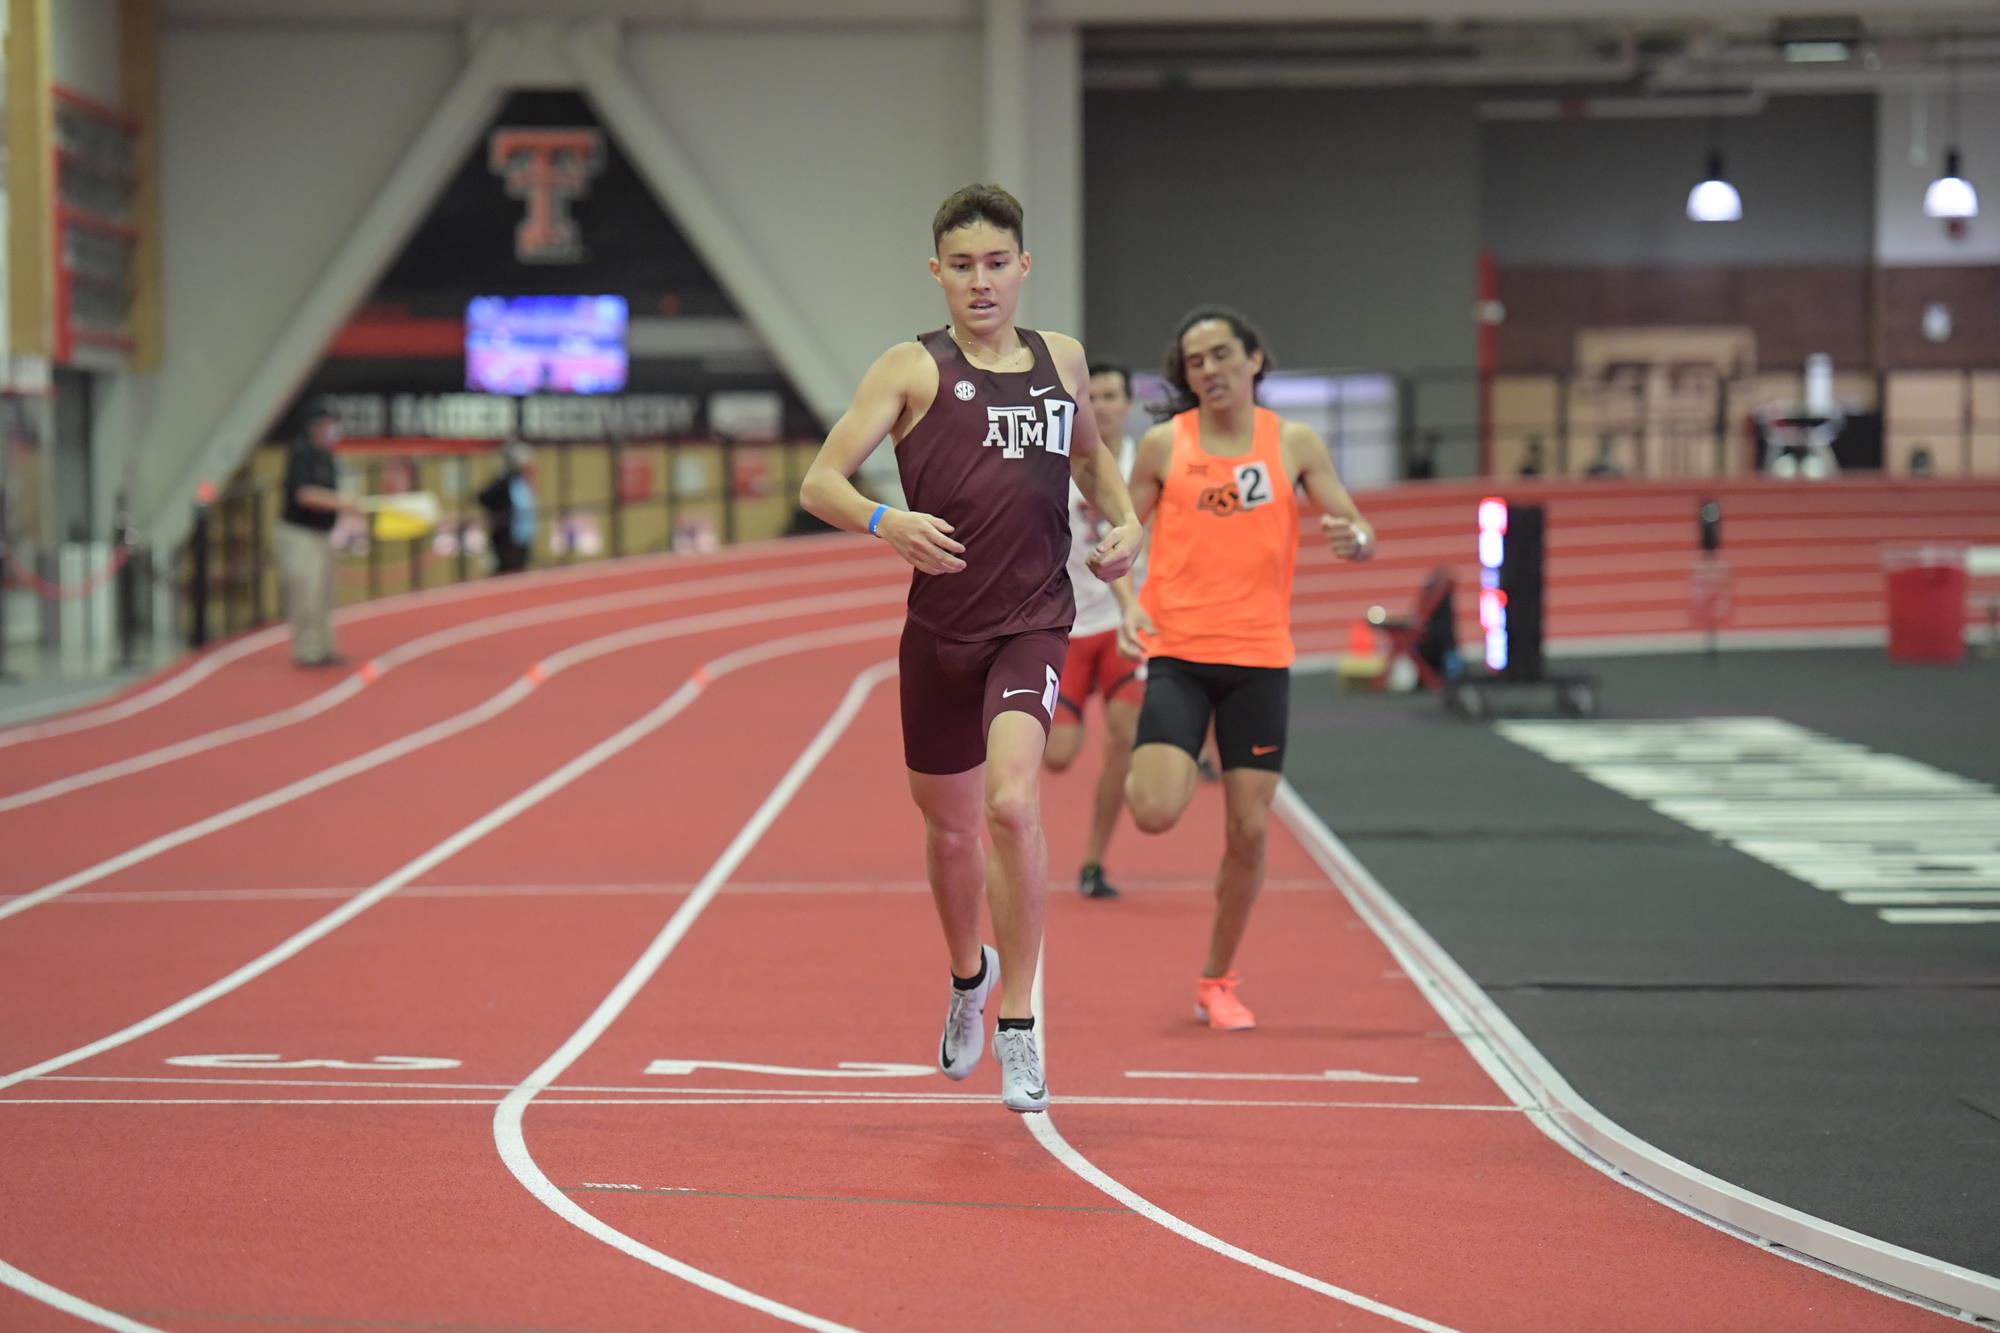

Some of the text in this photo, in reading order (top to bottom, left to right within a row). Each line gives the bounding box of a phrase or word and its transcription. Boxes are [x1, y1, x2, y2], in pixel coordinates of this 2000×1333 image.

[955, 381, 975, 400] SEC
[1052, 405, 1066, 451] 1
[1241, 468, 1266, 502] 2
[165, 1053, 462, 1070] 3
[644, 1059, 937, 1077] 2
[1124, 1070, 1419, 1083] 1
